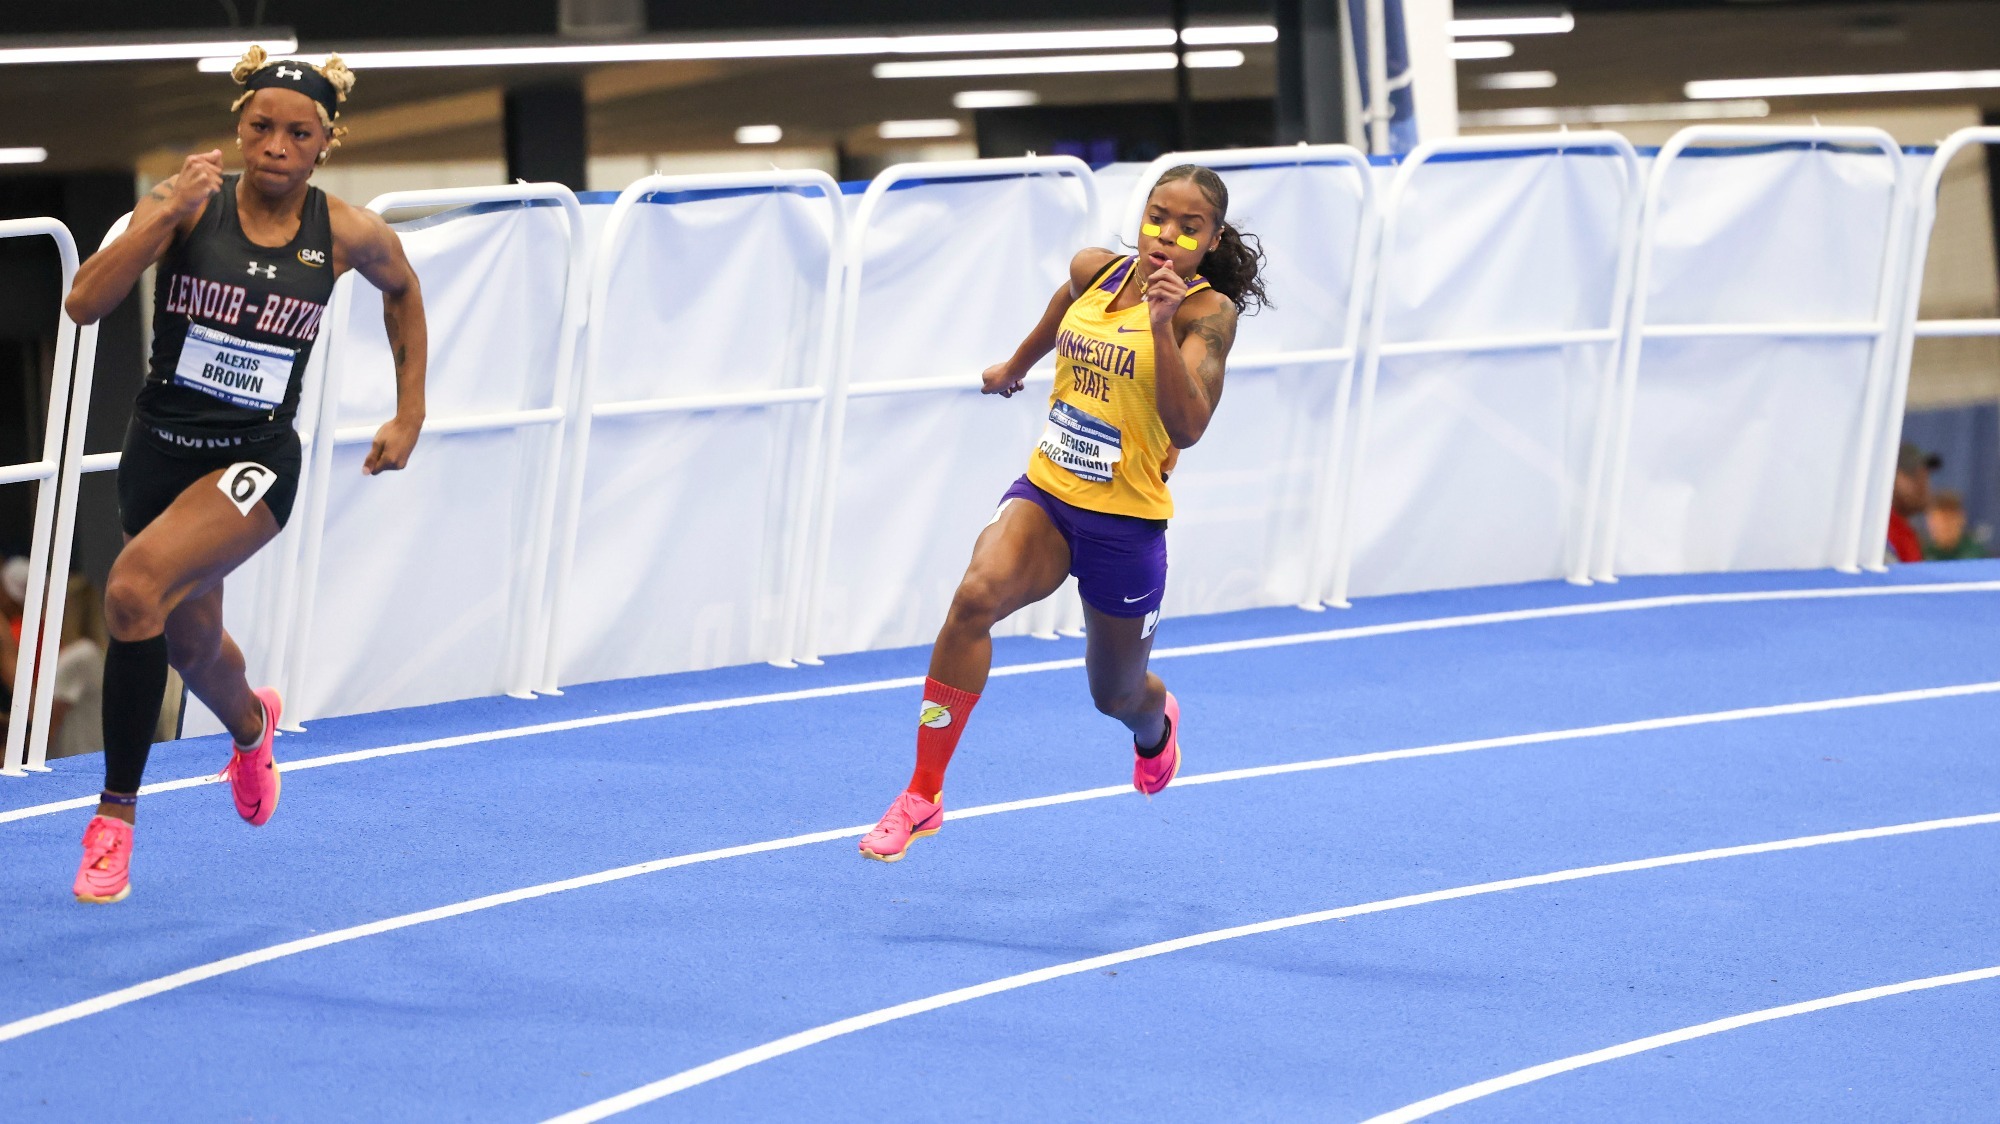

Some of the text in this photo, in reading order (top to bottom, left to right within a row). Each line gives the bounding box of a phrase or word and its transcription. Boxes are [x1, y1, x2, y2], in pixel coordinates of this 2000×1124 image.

[302, 249, 325, 264] SAC
[215, 351, 260, 372] ALEXIS
[1057, 329, 1136, 379] MINNESOTA
[202, 363, 264, 394] BROWN
[1072, 365, 1110, 402] STATE
[231, 466, 266, 503] 6
